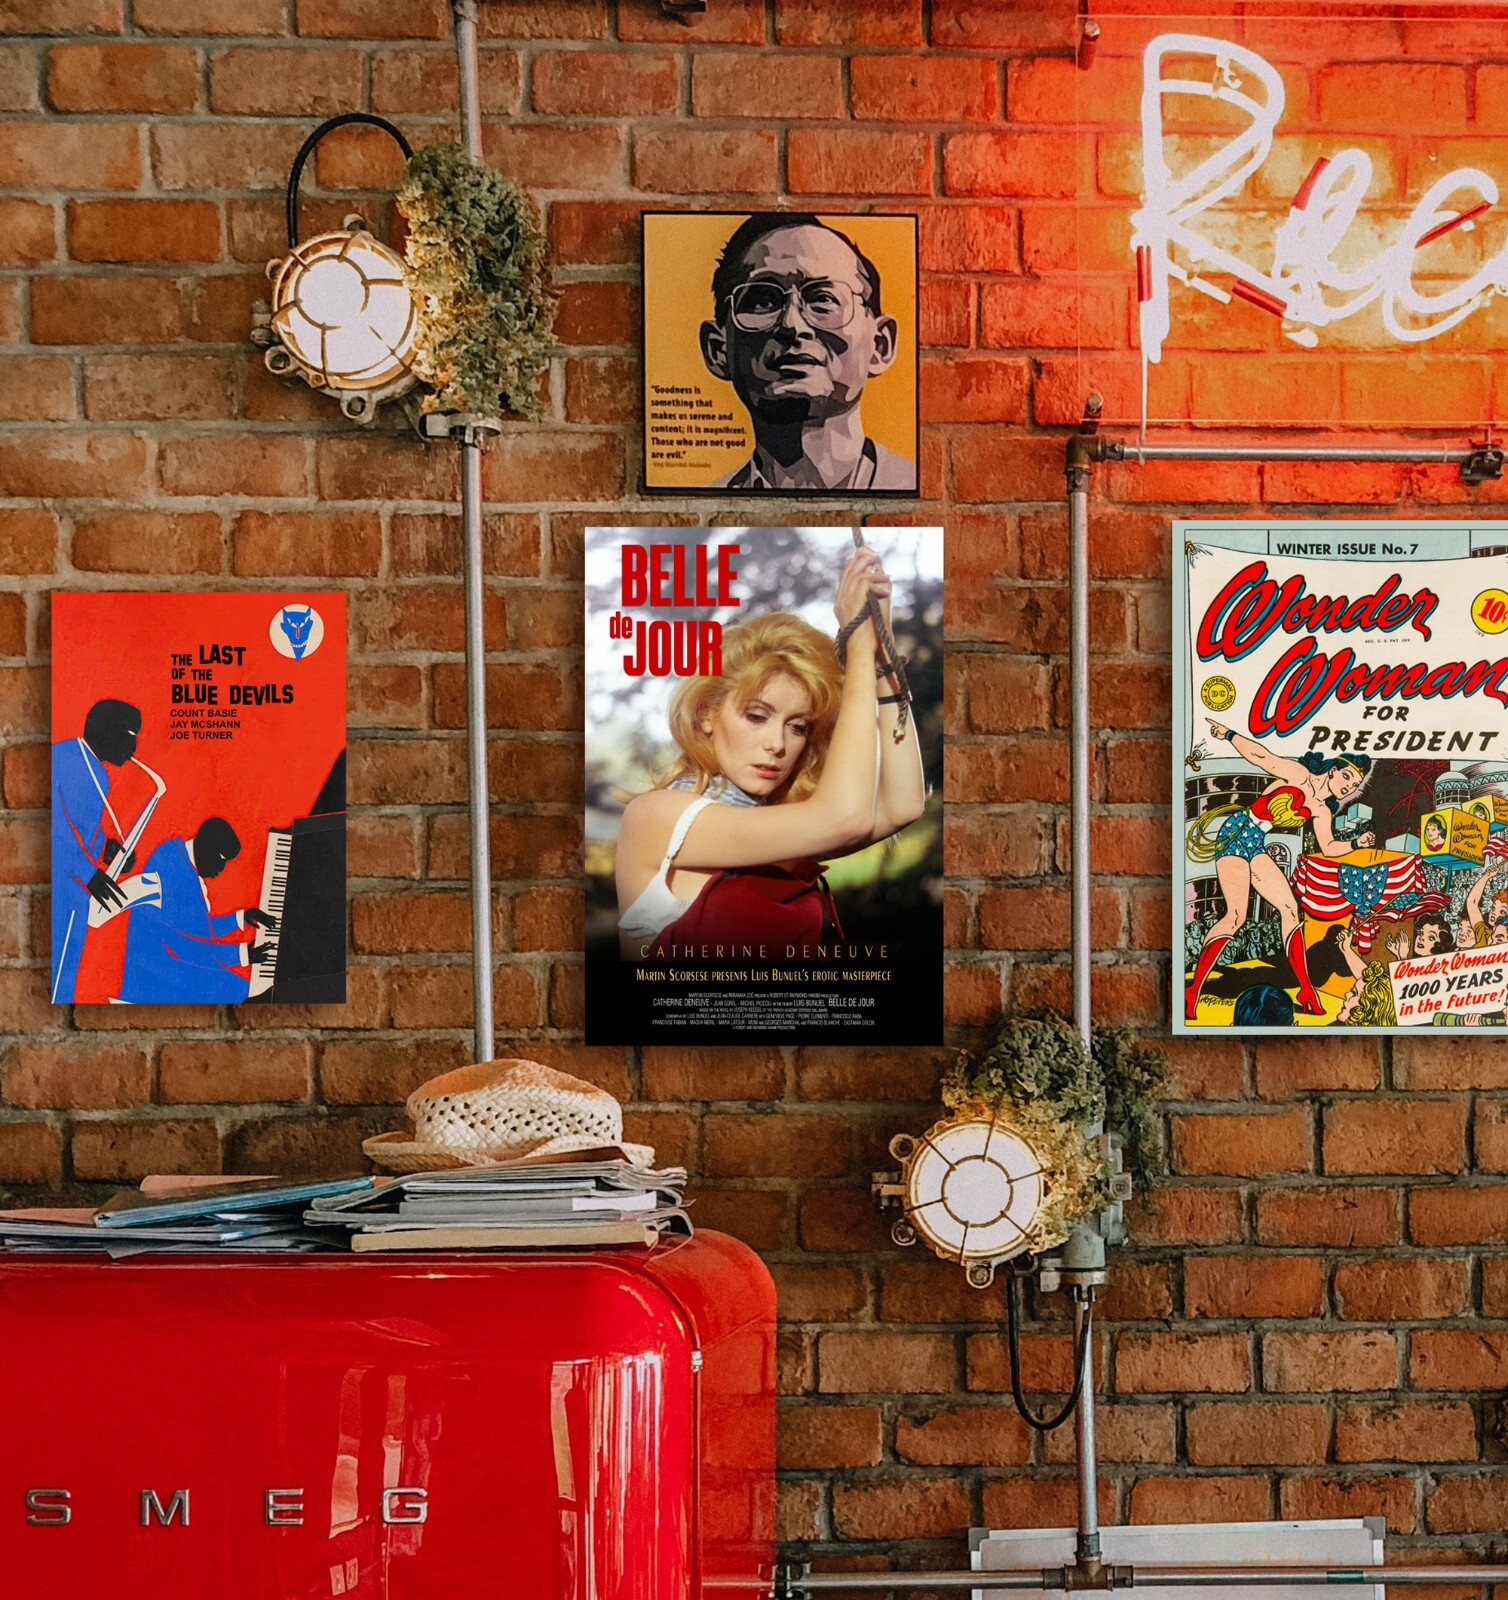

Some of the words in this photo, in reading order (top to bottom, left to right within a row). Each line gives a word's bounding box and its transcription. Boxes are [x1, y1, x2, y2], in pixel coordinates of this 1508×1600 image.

[651, 385, 692, 394] "Goodness
[694, 386, 701, 394] is
[651, 399, 693, 409] something
[695, 399, 713, 407] that
[651, 411, 676, 420] makes
[718, 411, 733, 420] and
[651, 425, 685, 434] content;
[687, 425, 693, 433] it
[651, 437, 674, 446] Those
[676, 438, 693, 446] who
[710, 439, 724, 447] not
[725, 439, 746, 449] good
[1277, 543, 1332, 555] WINTER
[1337, 543, 1376, 555] ISSUE
[1382, 543, 1407, 555] No.
[1410, 543, 1419, 555] 7
[621, 544, 740, 607] BELLE
[1196, 560, 1439, 663] Wonder
[609, 611, 633, 639] de
[171, 654, 192, 666] THE
[199, 644, 246, 666] LAST
[623, 620, 722, 676] JOUR
[171, 668, 185, 680] OF
[191, 669, 212, 681] THE
[171, 684, 218, 705] BLUE
[229, 684, 294, 705] DEVILS
[1248, 635, 1508, 740] Woman
[170, 709, 204, 717] COUNT
[208, 709, 237, 717] BASIE
[1362, 706, 1410, 721] FOR
[170, 720, 188, 729] JAY
[191, 720, 240, 729] MCSHANN
[170, 731, 189, 739] JOE
[193, 731, 233, 739] TURNER
[1308, 726, 1500, 752] PRESIDENT
[640, 945, 766, 958] CATHERINE
[786, 945, 888, 958] DENEUVE
[1394, 957, 1450, 979] Wonder
[1451, 952, 1508, 970] Woman
[1399, 980, 1441, 1000] 1000
[1446, 969, 1503, 992] YEARS
[828, 998, 847, 1007] BELLE
[848, 998, 857, 1007] DE
[858, 998, 875, 1007] JOUR
[1399, 1003, 1413, 1016] in
[1418, 998, 1442, 1013] the
[1447, 989, 1505, 1009] future!
[25, 1487, 429, 1527] SMEG
